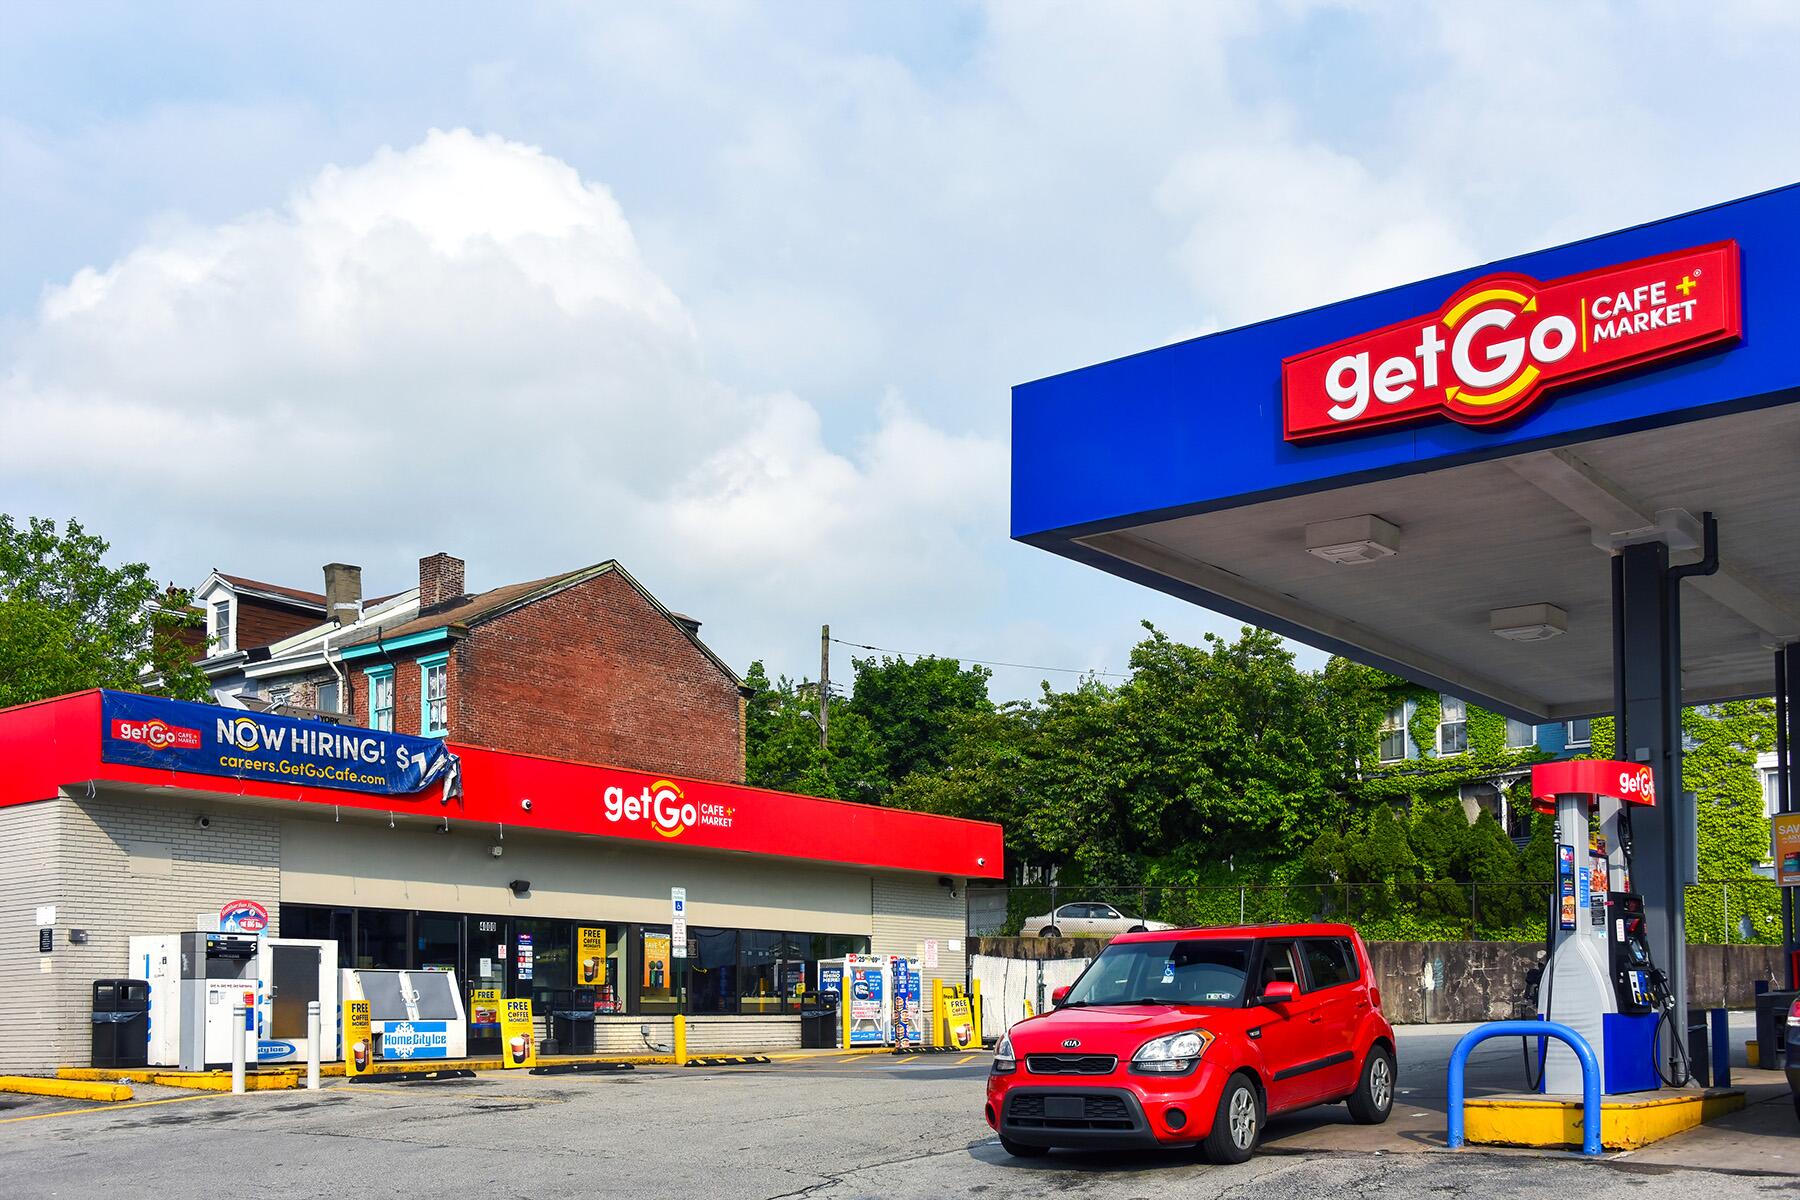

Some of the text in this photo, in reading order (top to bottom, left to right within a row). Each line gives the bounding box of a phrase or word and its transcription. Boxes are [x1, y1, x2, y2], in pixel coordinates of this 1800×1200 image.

[1591, 280, 1667, 320] CAFE
[1592, 298, 1698, 344] MARKET
[1325, 308, 1577, 422] getGo
[319, 715, 340, 724] YORK
[120, 722, 175, 743] getGo
[216, 717, 286, 751] NOW
[291, 728, 386, 765] HIRING!
[219, 754, 386, 786] careers.GetGoCafe.com
[603, 786, 697, 828] getGo
[701, 803, 725, 817] CAFE
[701, 815, 733, 827] MARKET
[583, 929, 601, 938] FREE
[351, 1003, 369, 1013] FREE
[507, 1002, 528, 1011] FREE
[950, 999, 968, 1007] FREE
